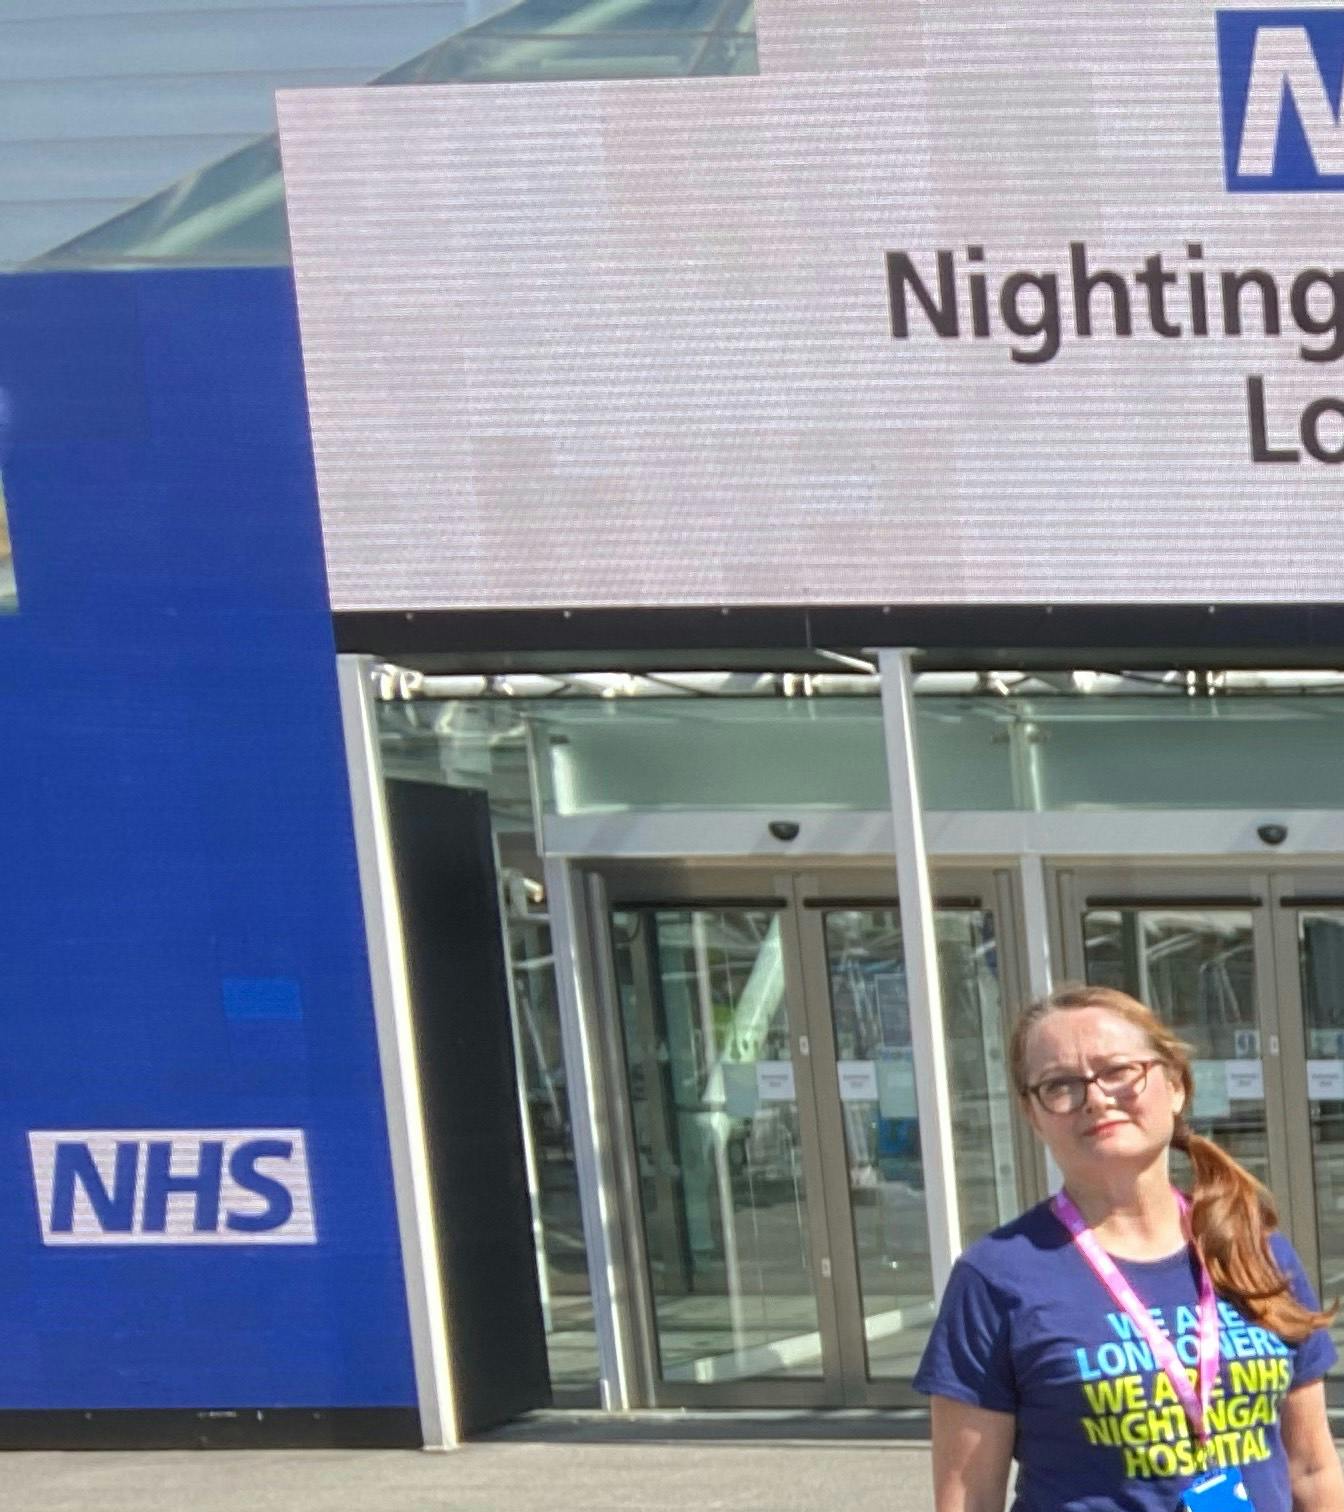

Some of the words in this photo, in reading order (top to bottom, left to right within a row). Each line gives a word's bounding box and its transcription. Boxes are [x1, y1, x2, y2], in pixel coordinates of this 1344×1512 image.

[48, 1138, 294, 1234] NHS
[1076, 1325, 1290, 1381] LONONERS
[1083, 1374, 1148, 1415] WE
[1229, 1358, 1291, 1394] NHS
